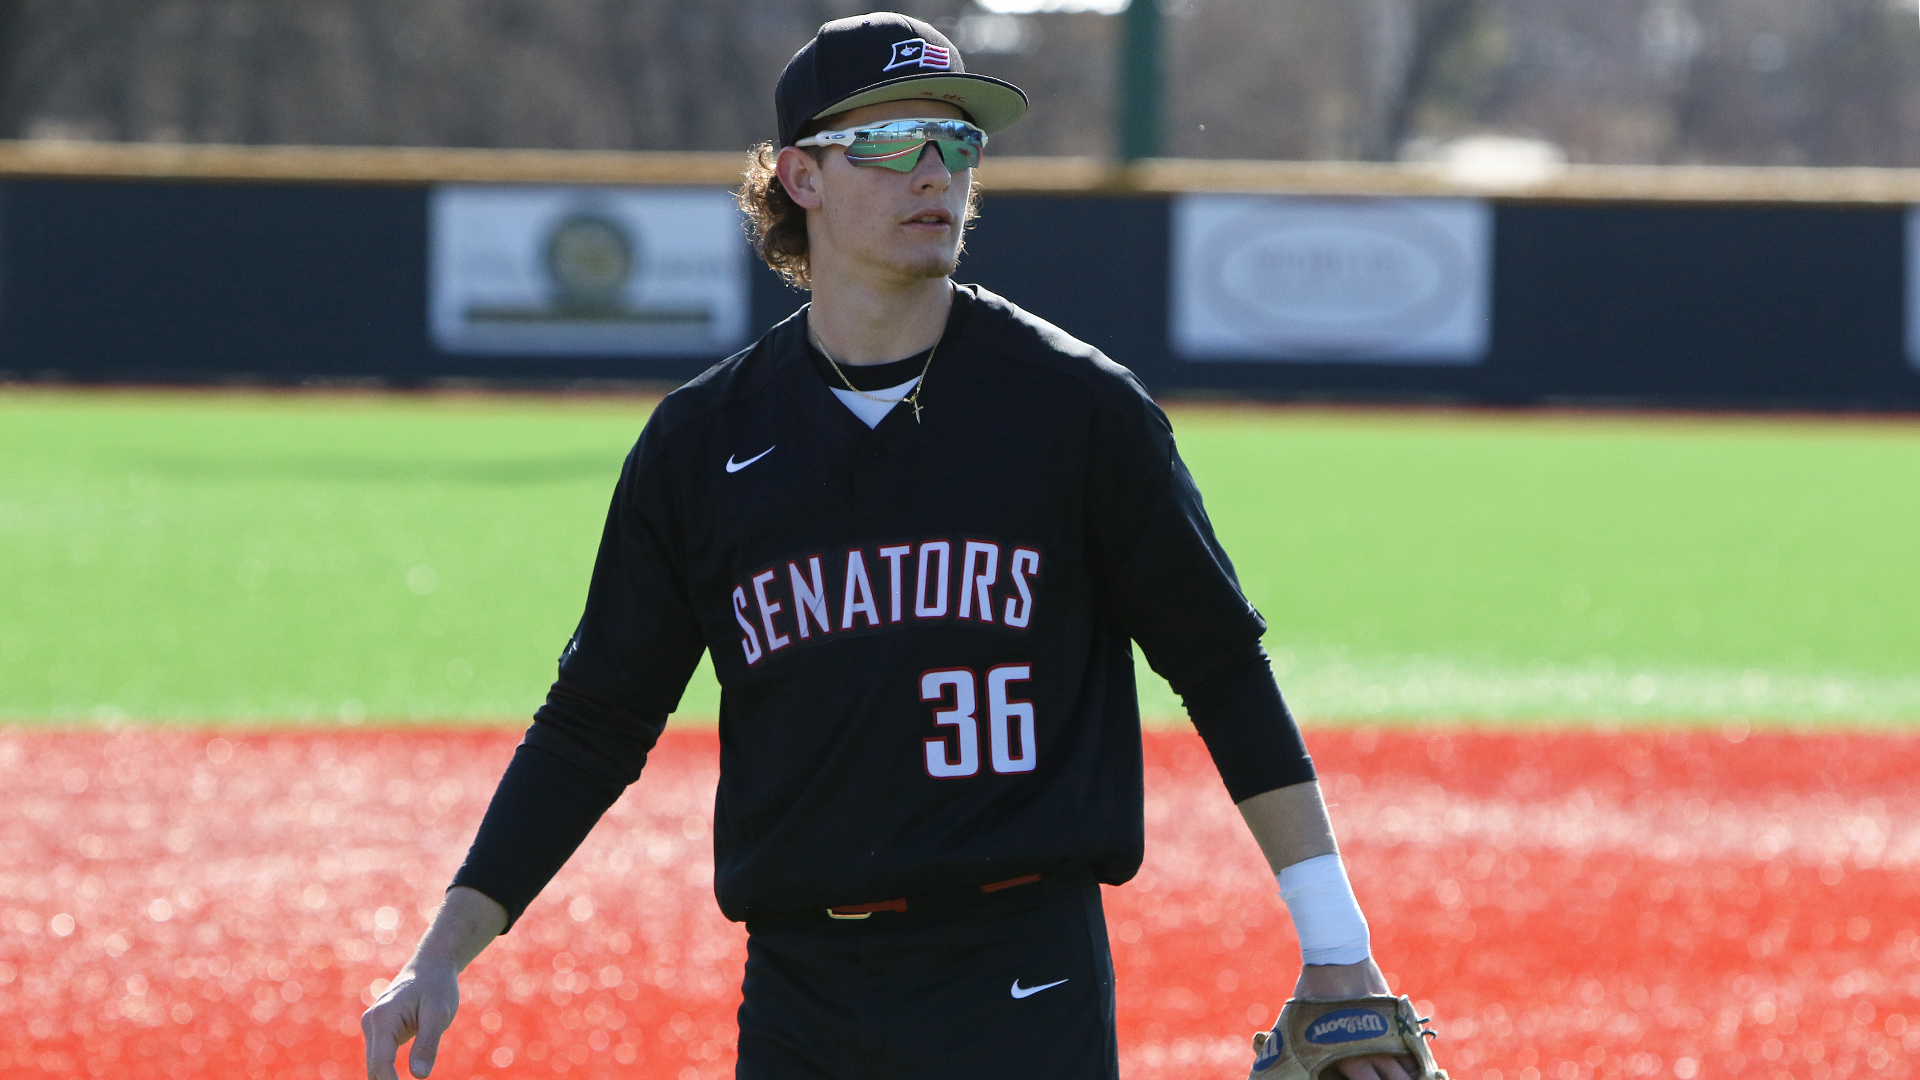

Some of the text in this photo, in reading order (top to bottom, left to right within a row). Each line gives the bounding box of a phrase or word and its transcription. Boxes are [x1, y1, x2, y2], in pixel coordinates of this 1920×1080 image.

[731, 539, 1041, 667] SENATORS
[919, 663, 1038, 779] 36
[1314, 1014, 1384, 1037] Wilson
